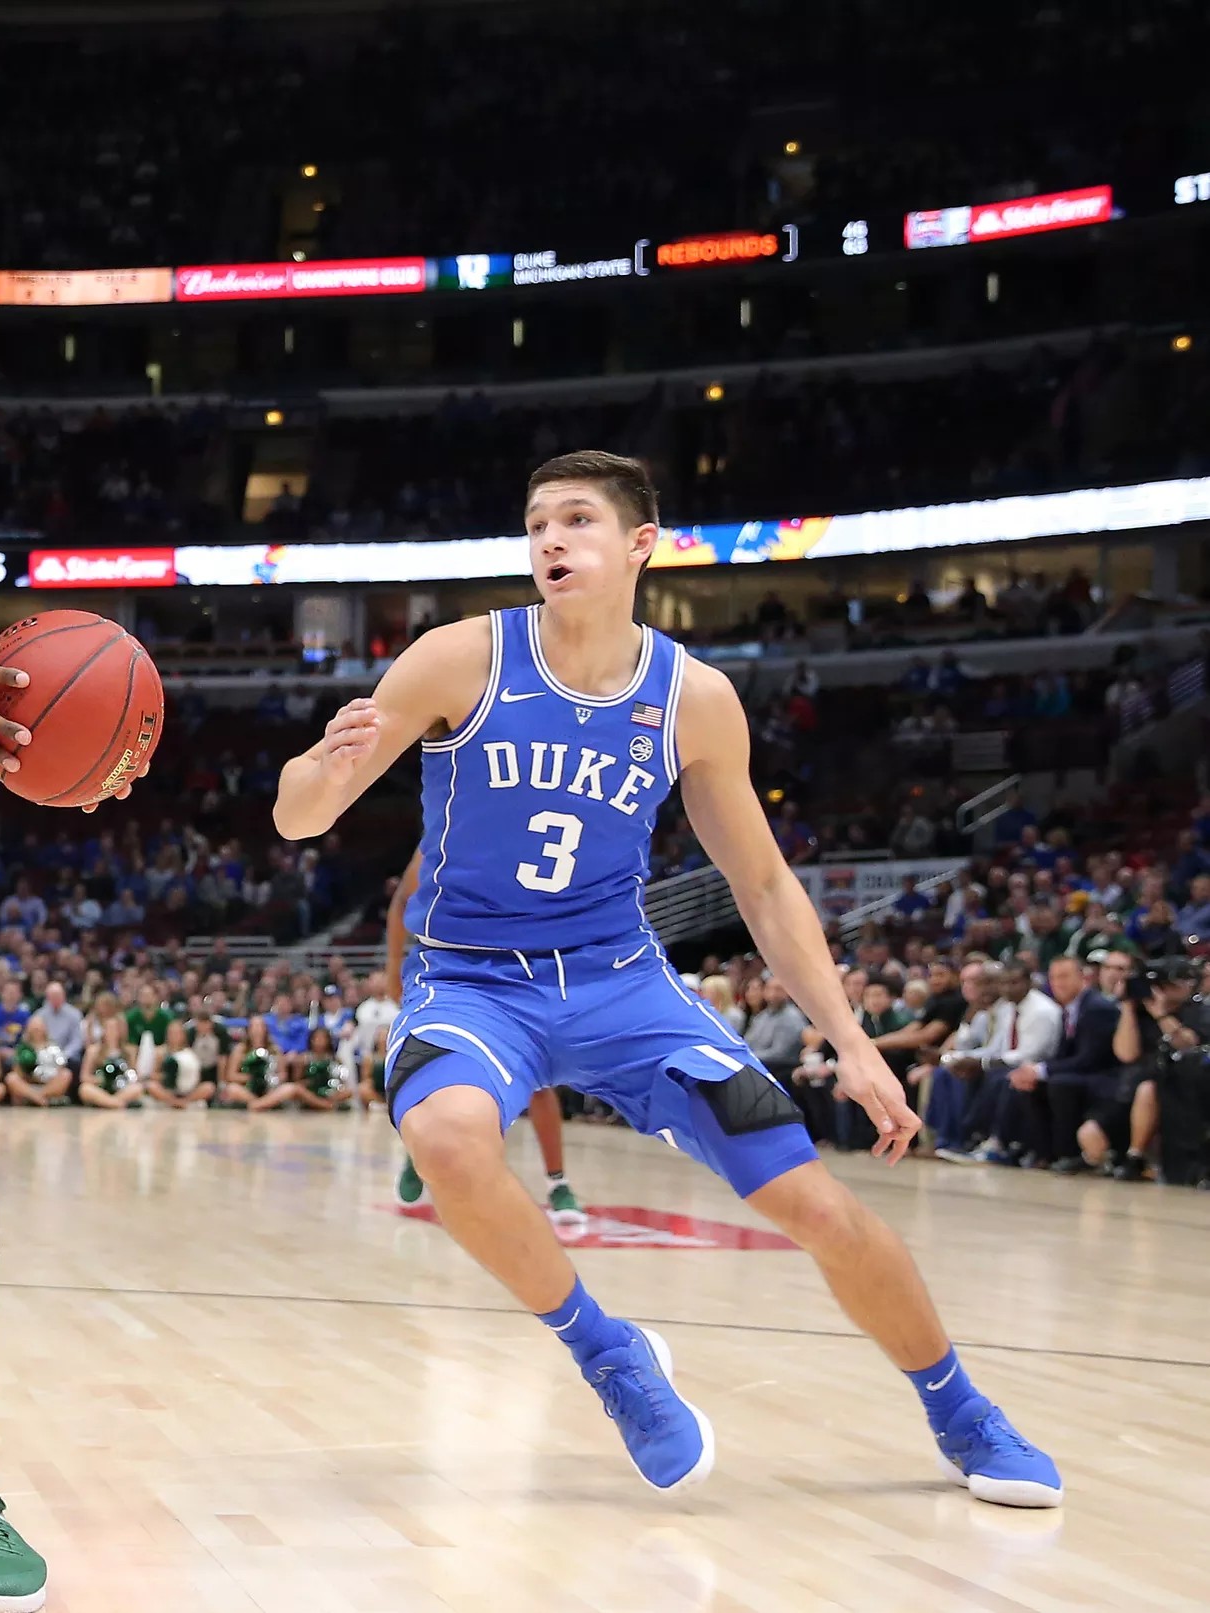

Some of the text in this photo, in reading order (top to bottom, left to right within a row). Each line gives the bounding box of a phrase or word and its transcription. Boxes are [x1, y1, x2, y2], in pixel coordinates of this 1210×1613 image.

[657, 234, 778, 266] REBOUNDS
[181, 270, 286, 295] Budweiser
[483, 741, 655, 816] DUKE
[515, 810, 584, 893] 3
